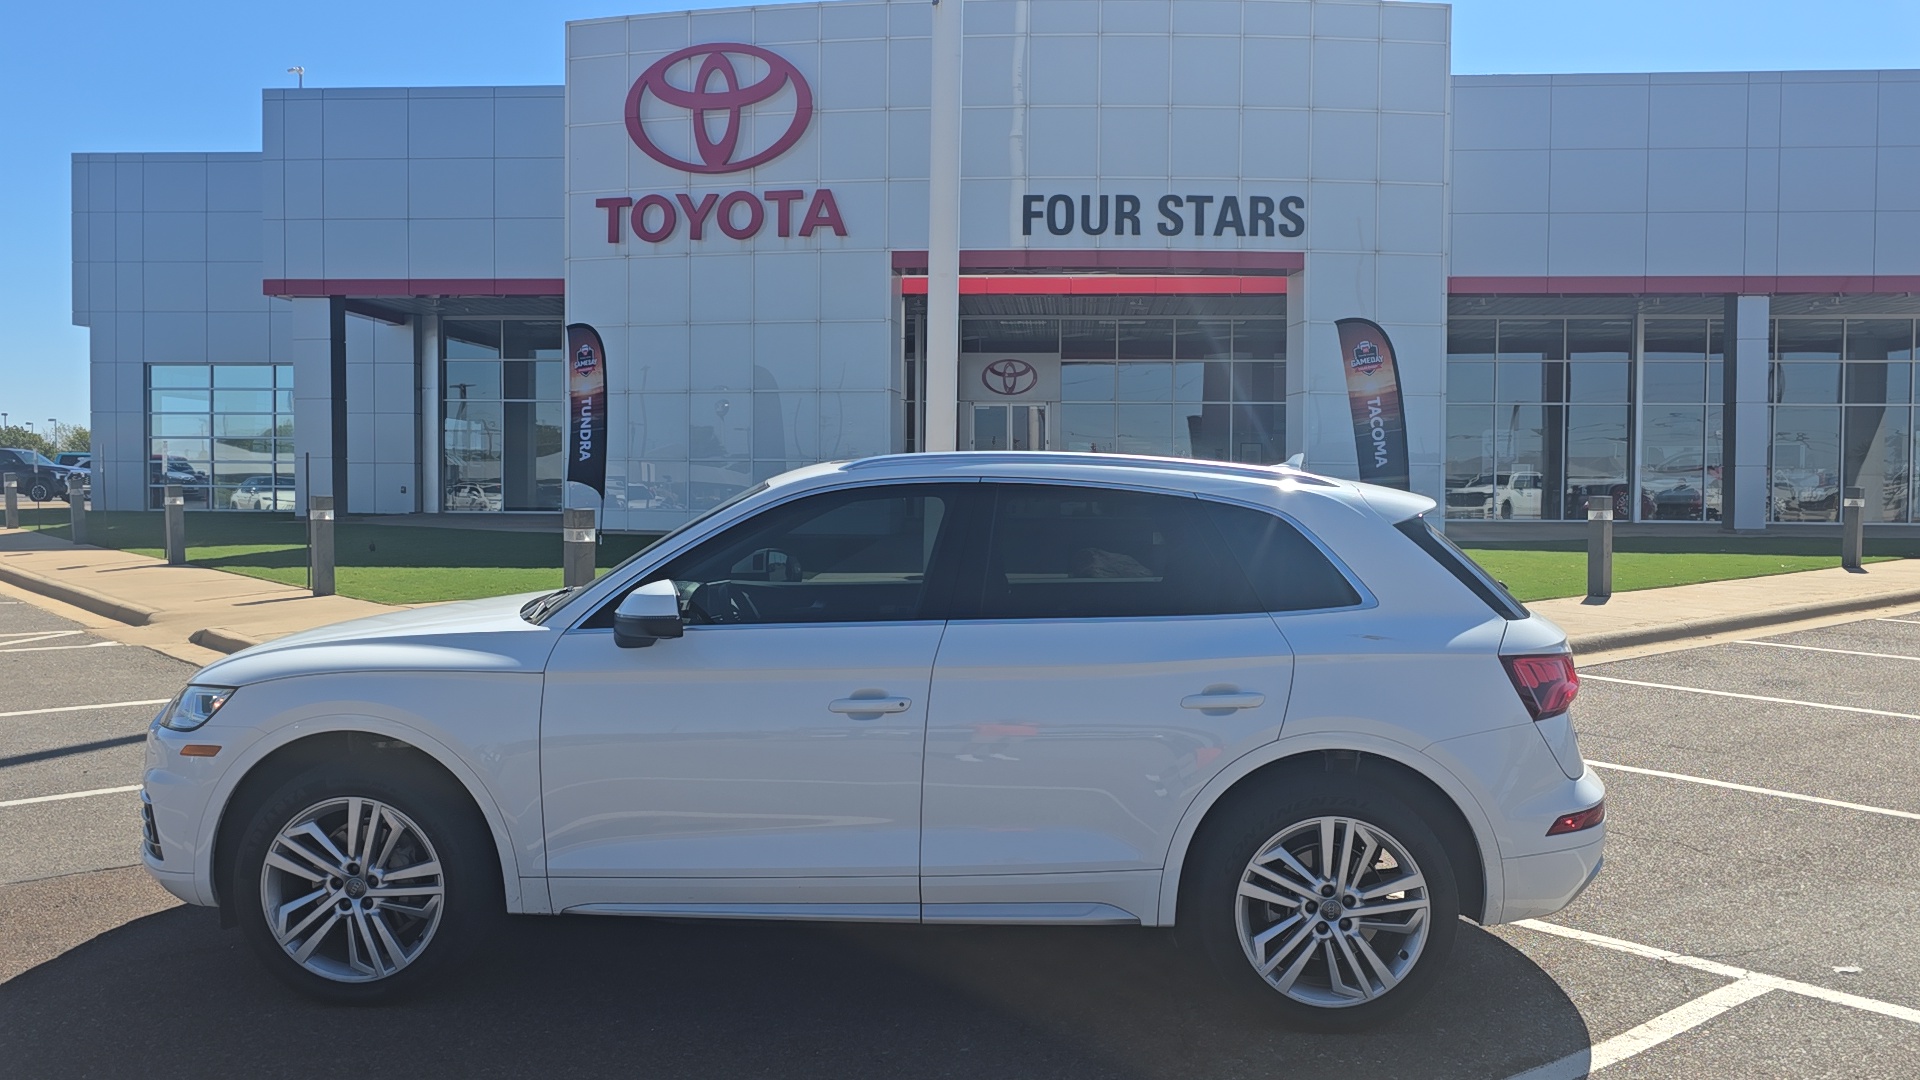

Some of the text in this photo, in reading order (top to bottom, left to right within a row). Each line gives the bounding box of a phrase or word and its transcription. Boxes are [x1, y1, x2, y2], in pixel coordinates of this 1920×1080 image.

[596, 189, 848, 243] TOYOTA
[1022, 194, 1305, 237] FOUR STARS
[1350, 355, 1384, 368] GAMEDAY
[579, 397, 592, 461] TUNDRA
[1367, 396, 1388, 468] TACOMA
